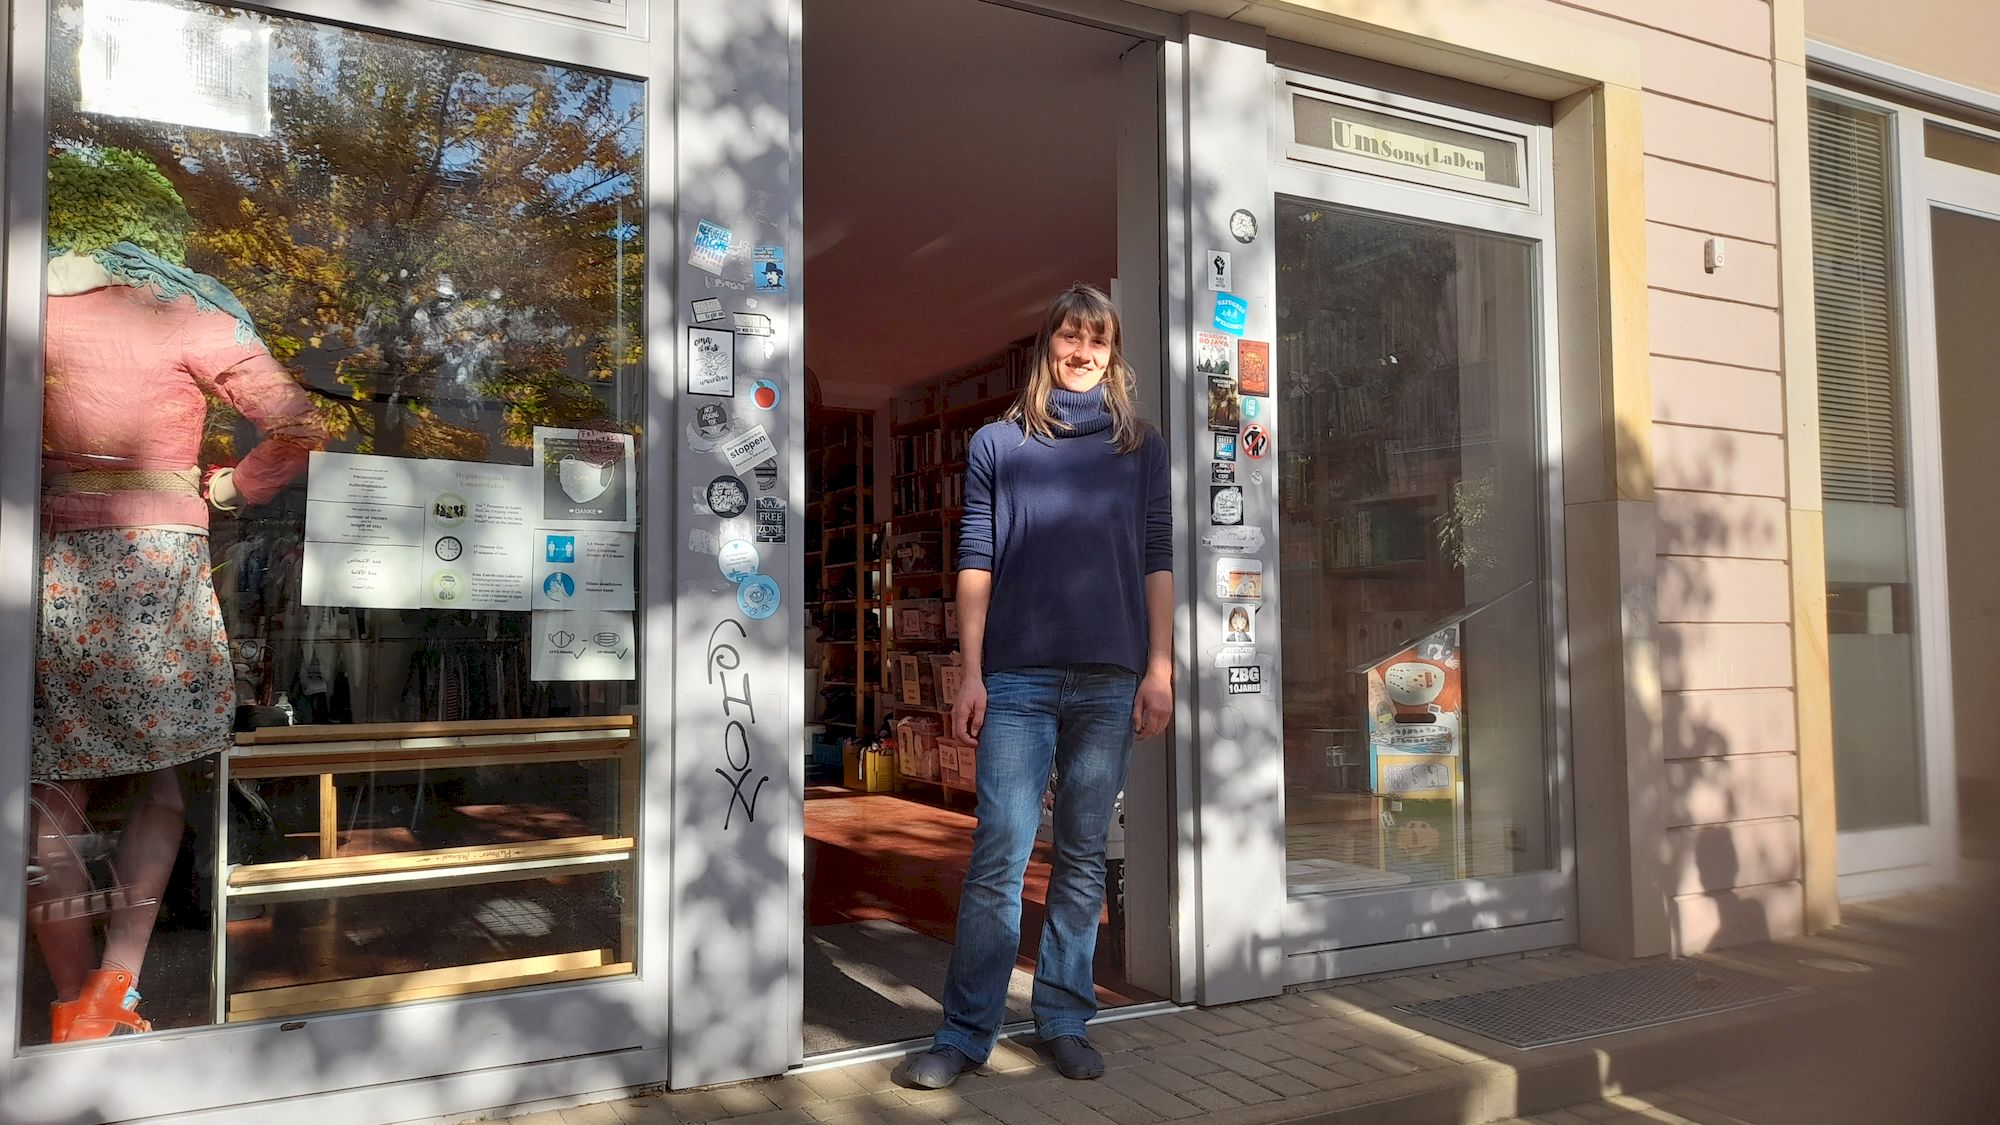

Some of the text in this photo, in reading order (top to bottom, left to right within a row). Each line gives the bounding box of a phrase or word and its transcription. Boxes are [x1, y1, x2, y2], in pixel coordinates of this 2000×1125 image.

[1199, 337, 1229, 348] ROJAVA
[730, 435, 766, 459] stoppen
[759, 512, 783, 521] FREE
[758, 525, 784, 533] ZONE
[1230, 667, 1260, 683] ZBG
